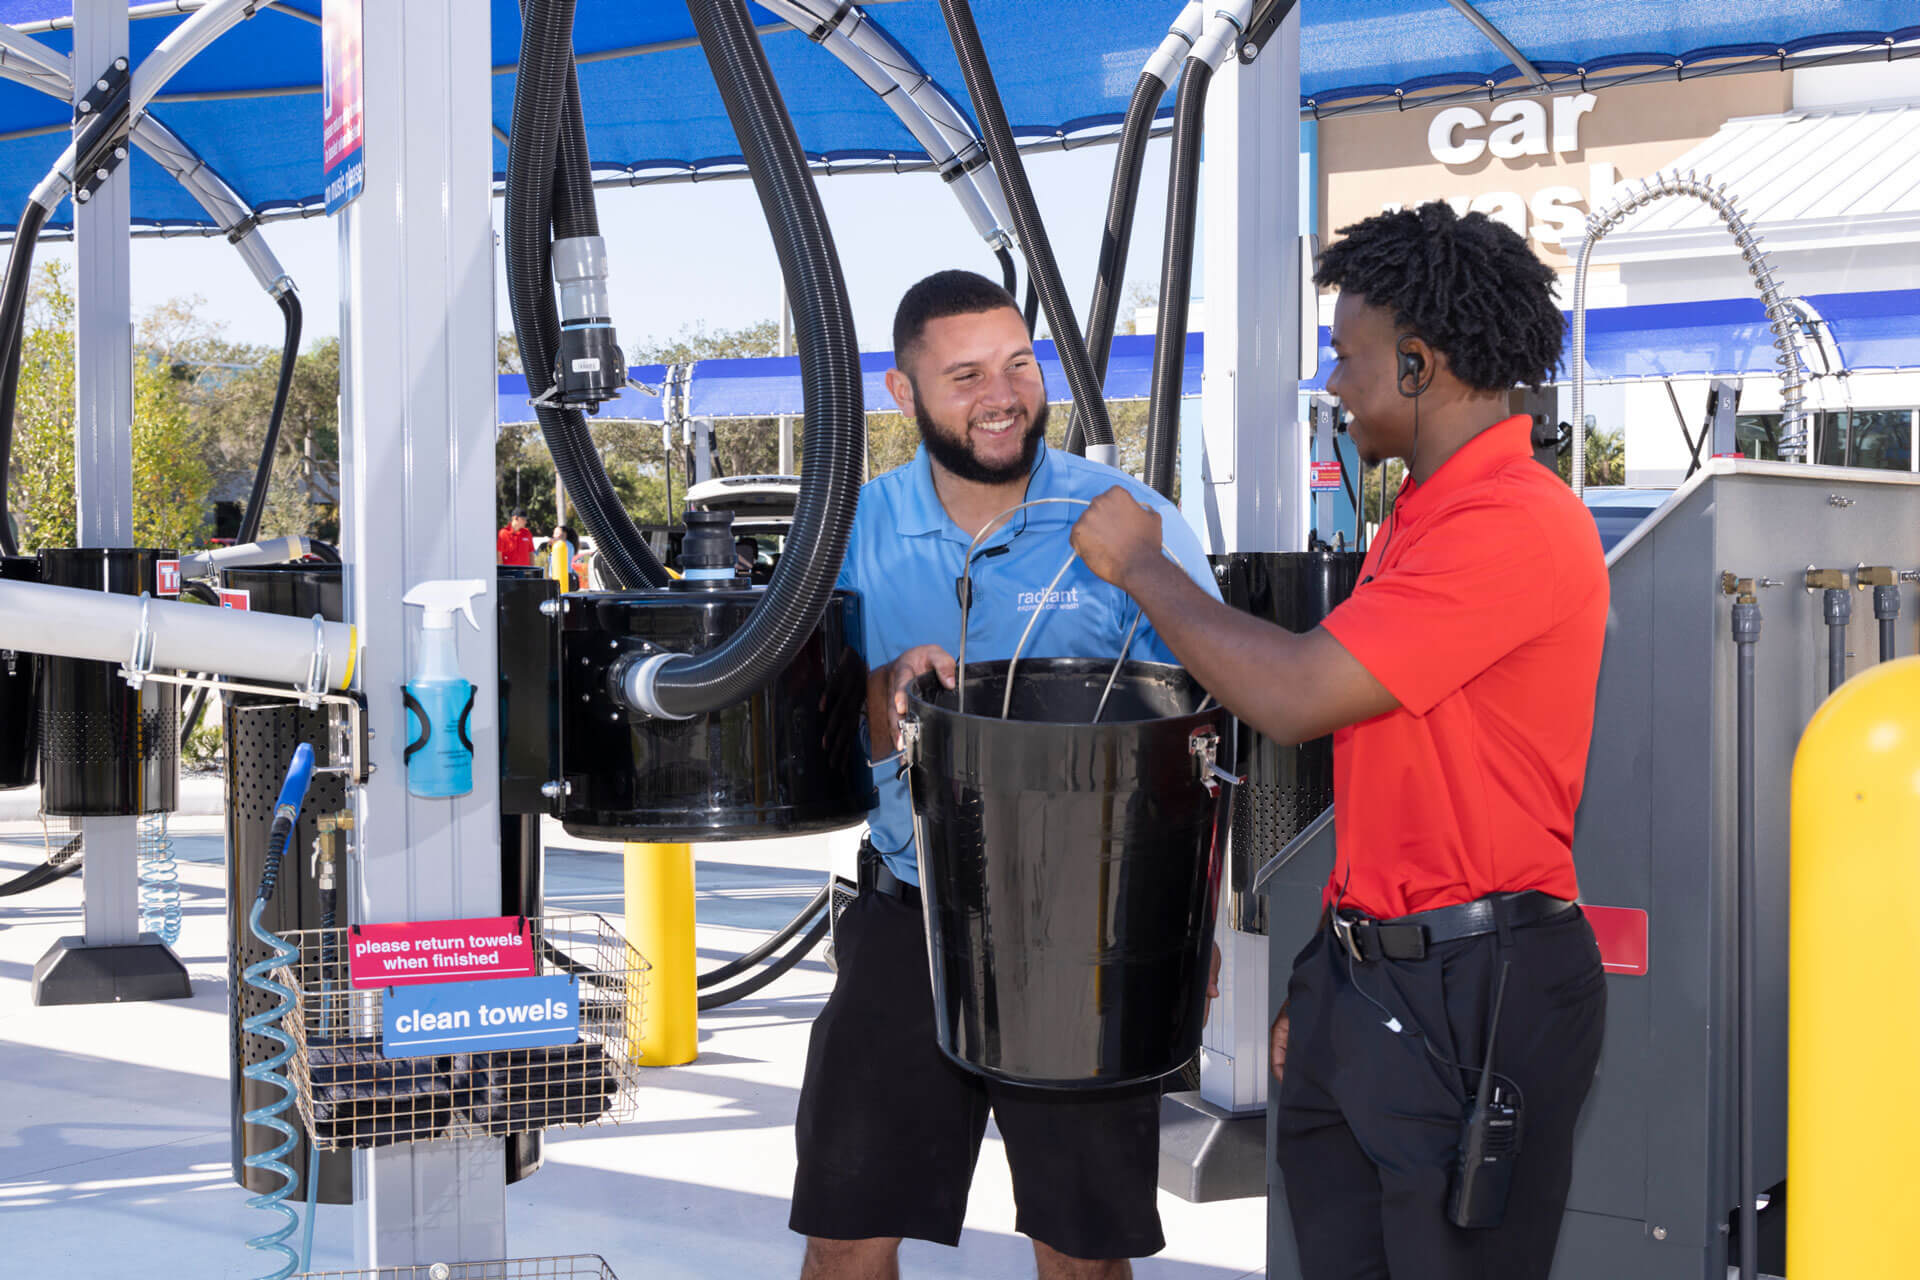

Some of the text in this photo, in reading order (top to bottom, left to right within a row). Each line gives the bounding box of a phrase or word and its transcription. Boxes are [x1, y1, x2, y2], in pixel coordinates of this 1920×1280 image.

[1428, 93, 1597, 164] car
[331, 170, 345, 200] music
[345, 161, 362, 199] please
[1380, 163, 1646, 245] ash
[355, 932, 523, 957] please return towels
[383, 951, 499, 970] when finished
[395, 998, 568, 1033] clean towels
